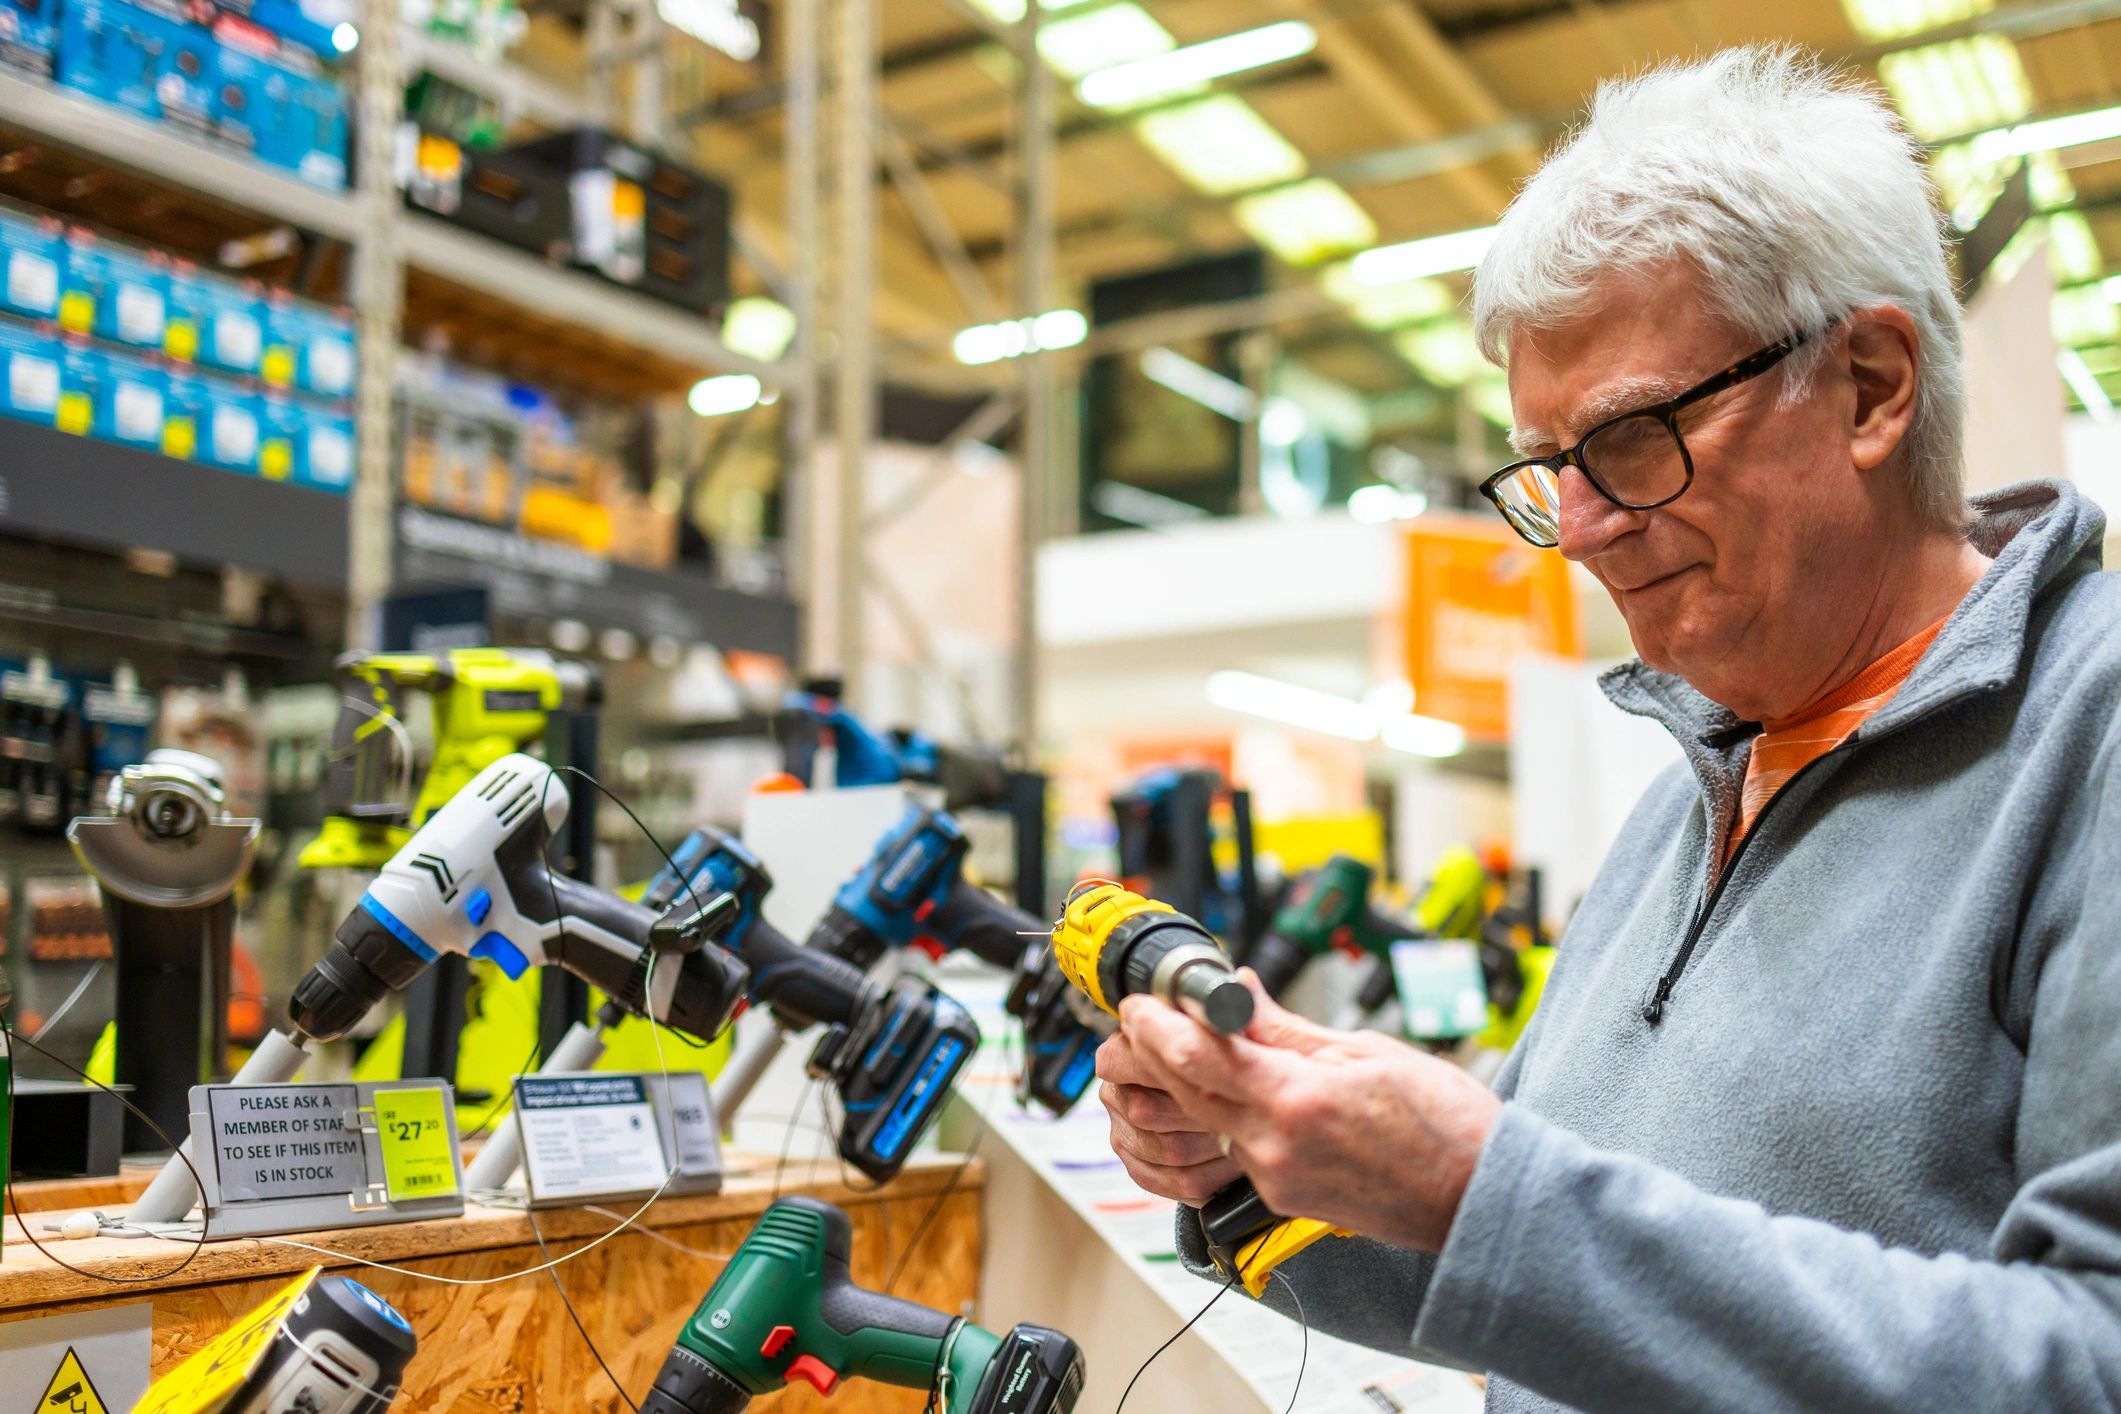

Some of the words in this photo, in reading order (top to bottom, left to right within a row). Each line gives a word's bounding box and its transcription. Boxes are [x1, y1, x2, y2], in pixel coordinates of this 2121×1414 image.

[240, 1096, 289, 1110] PLEASE
[293, 1095, 319, 1108] ASK
[322, 1095, 332, 1108] A
[224, 1120, 288, 1136] MEMBER
[291, 1119, 310, 1132] OF
[313, 1118, 344, 1131] STAF
[224, 1146, 244, 1160] TO
[248, 1145, 272, 1159] SEE
[275, 1144, 287, 1158] IF
[290, 1143, 321, 1157] THIS
[324, 1141, 358, 1155] ITEM
[255, 1170, 268, 1183] IS
[271, 1168, 286, 1182] IN
[290, 1166, 334, 1180] STOCK
[1001, 1373, 1020, 1404] Weighted
[1015, 1350, 1032, 1374] Dummy
[1015, 1368, 1032, 1392] Battery
